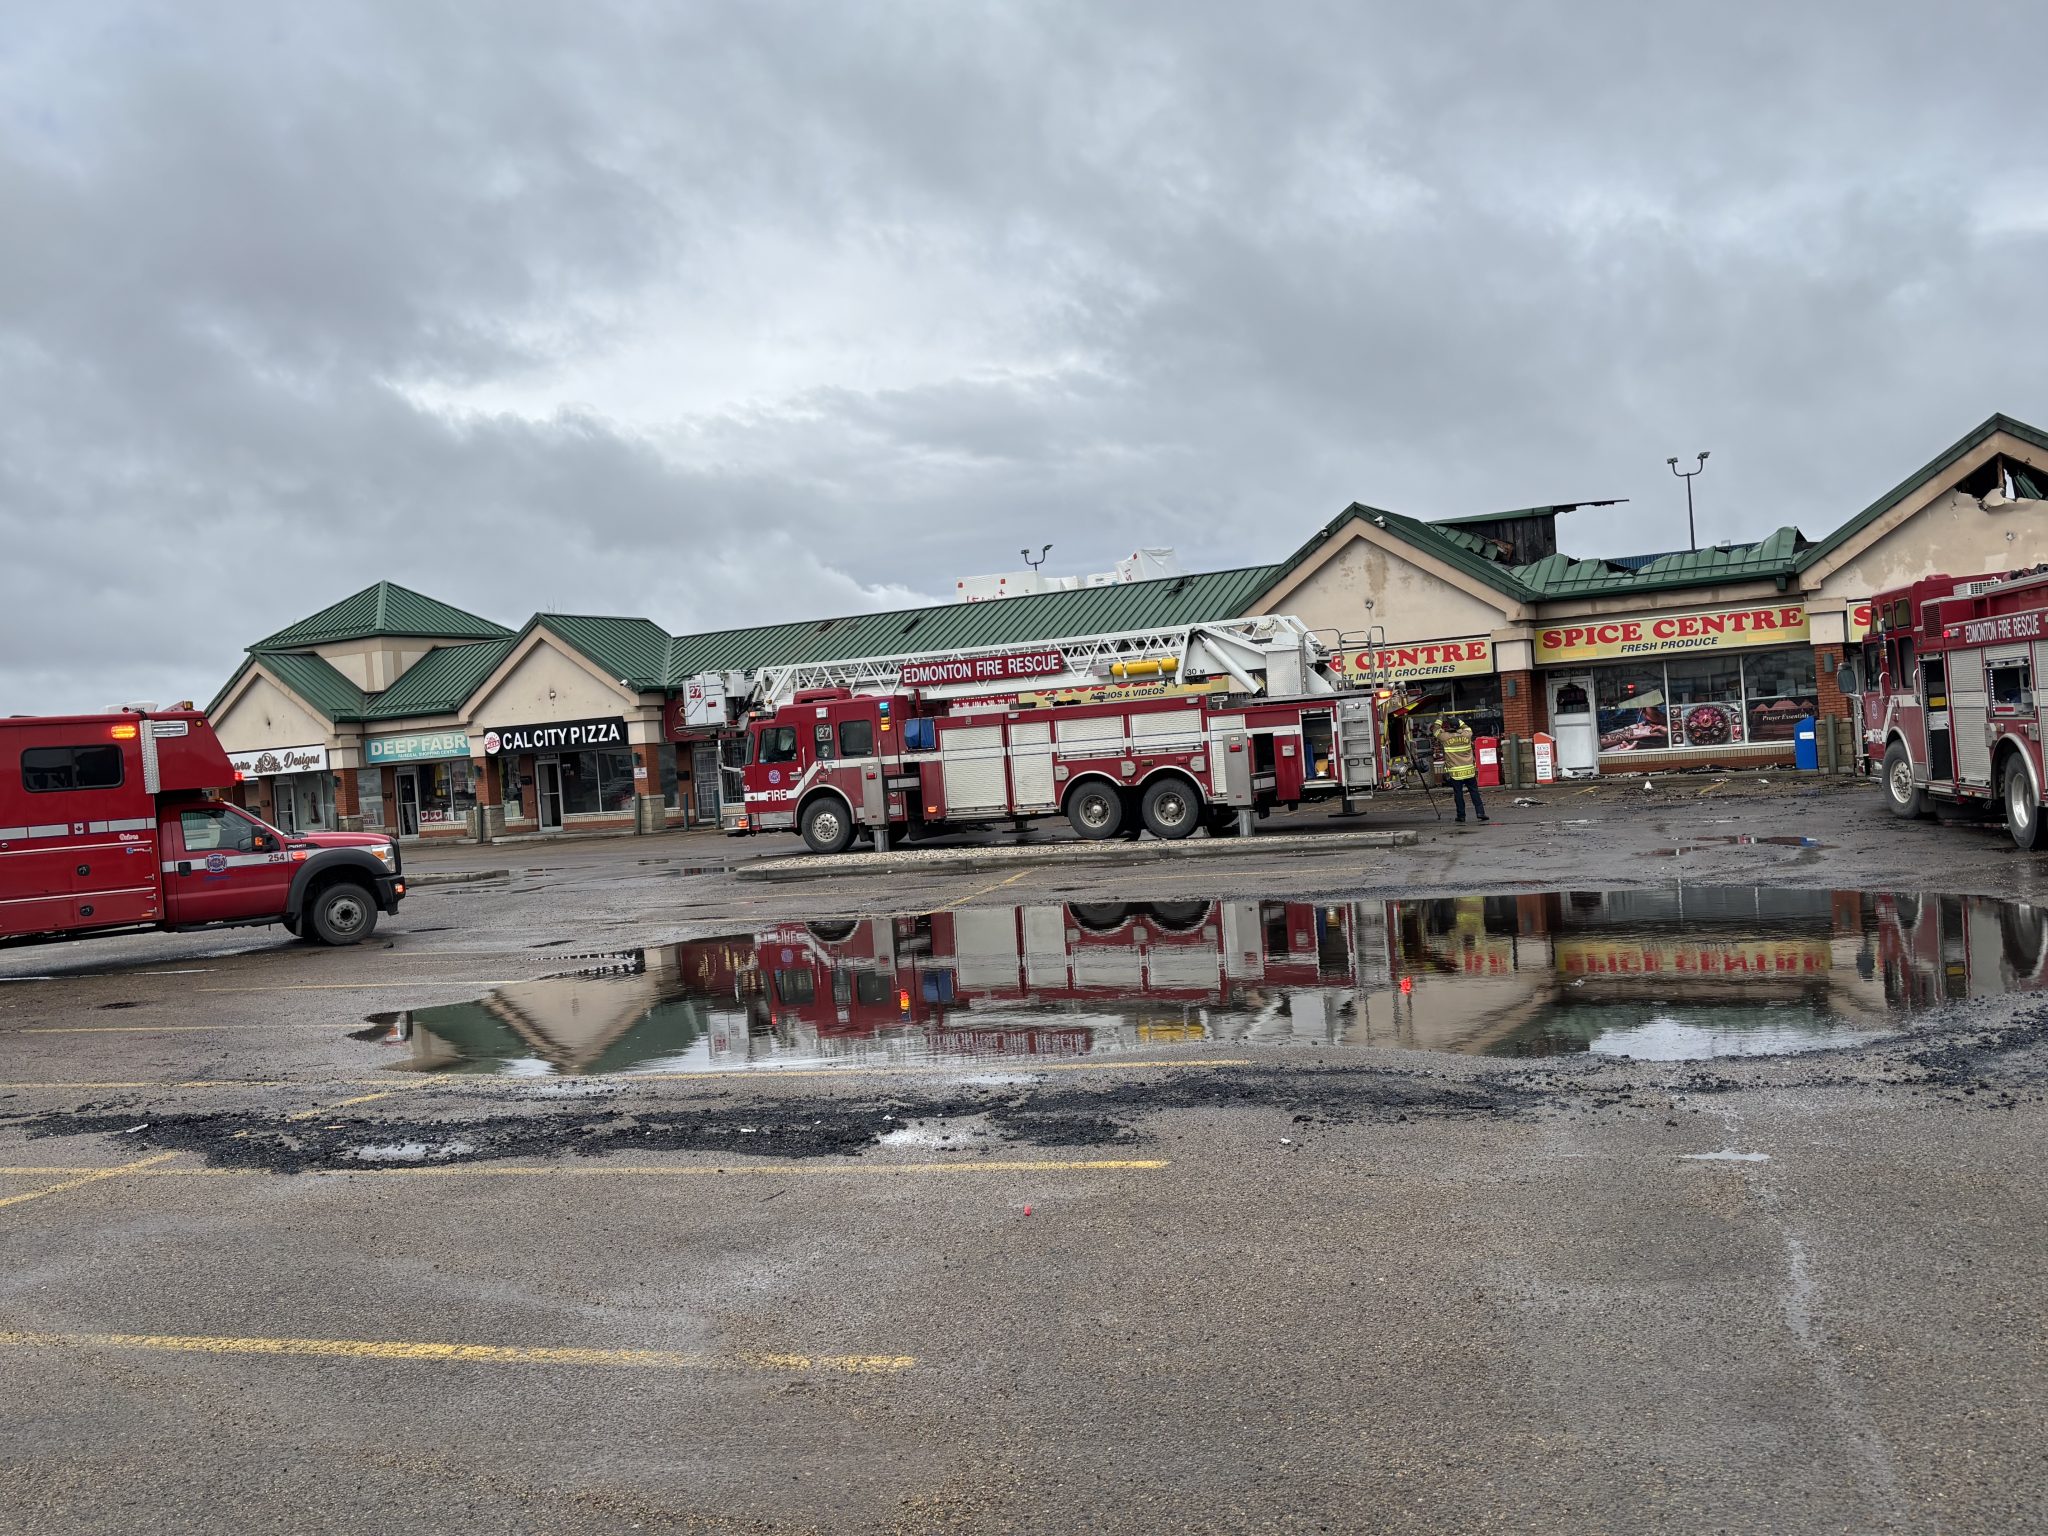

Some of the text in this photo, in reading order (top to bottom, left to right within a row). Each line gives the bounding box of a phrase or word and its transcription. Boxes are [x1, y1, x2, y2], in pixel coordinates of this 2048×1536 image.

[1542, 607, 1804, 648] SPICE CENTRE
[1965, 614, 2040, 643] EDMONTON FIRE RESCUE
[1620, 637, 1719, 653] FRESH PRODUCE
[1355, 641, 1487, 670] CENTRE
[903, 654, 1060, 684] EDMONTON FIRE RESCUE
[1186, 668, 1197, 676] 30
[1394, 664, 1456, 678] GROCERIES
[690, 686, 701, 698] 27
[1124, 690, 1130, 698] &
[1132, 687, 1165, 697] VIDEOS
[570, 723, 620, 744] PIZZA
[818, 727, 830, 738] 27
[370, 739, 418, 756] DEEP
[284, 751, 320, 770] Designs
[766, 789, 788, 801] FIRE
[268, 853, 285, 863] 254
